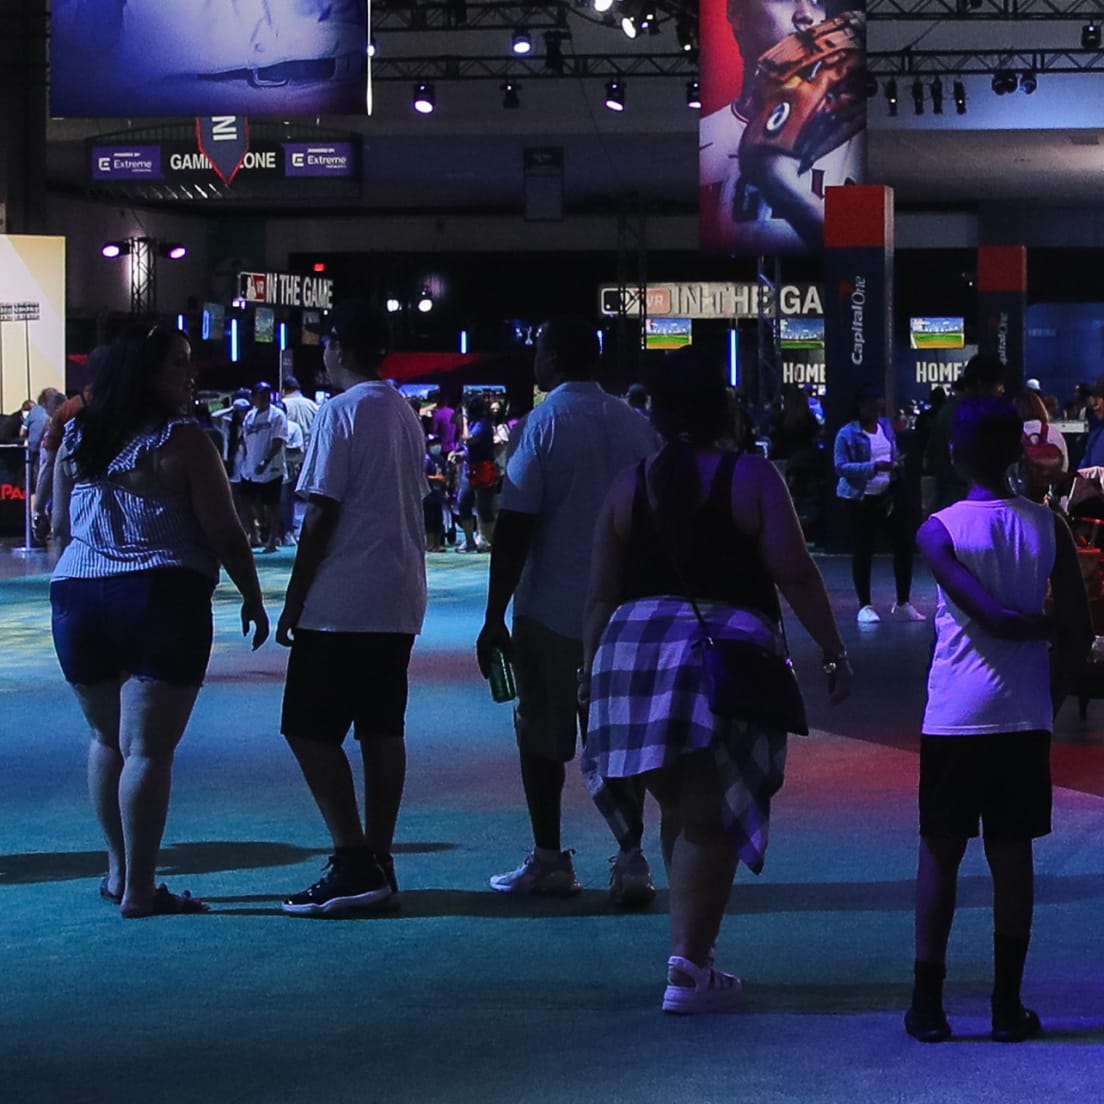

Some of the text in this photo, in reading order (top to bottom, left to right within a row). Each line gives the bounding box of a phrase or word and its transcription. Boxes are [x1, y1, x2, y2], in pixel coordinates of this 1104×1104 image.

[113, 159, 152, 169] Extreme
[239, 152, 276, 169] ONE
[307, 155, 347, 166] Extreme
[266, 273, 278, 304] IN
[280, 275, 301, 306] THE
[302, 277, 334, 309] GAME
[1, 484, 28, 500] PA
